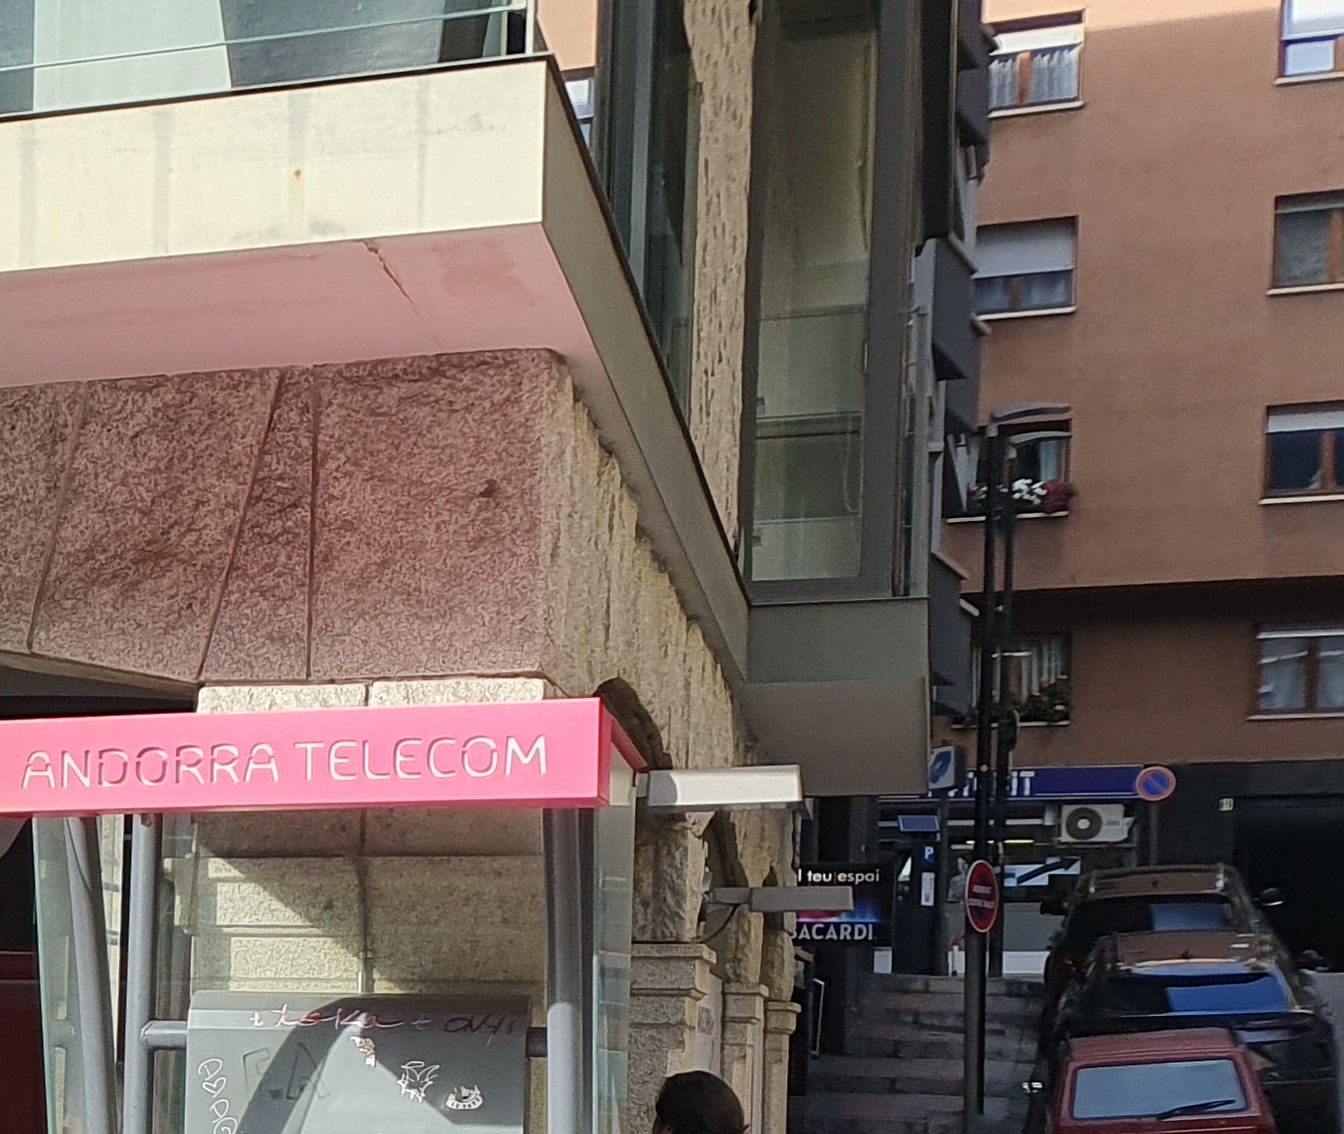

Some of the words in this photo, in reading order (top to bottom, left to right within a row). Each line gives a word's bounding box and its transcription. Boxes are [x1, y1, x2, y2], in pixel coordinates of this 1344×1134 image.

[20, 743, 280, 790] ANDORRA
[295, 734, 548, 783] TELECOM
[924, 846, 935, 860] P
[807, 869, 833, 882] teu
[837, 868, 880, 885] espai
